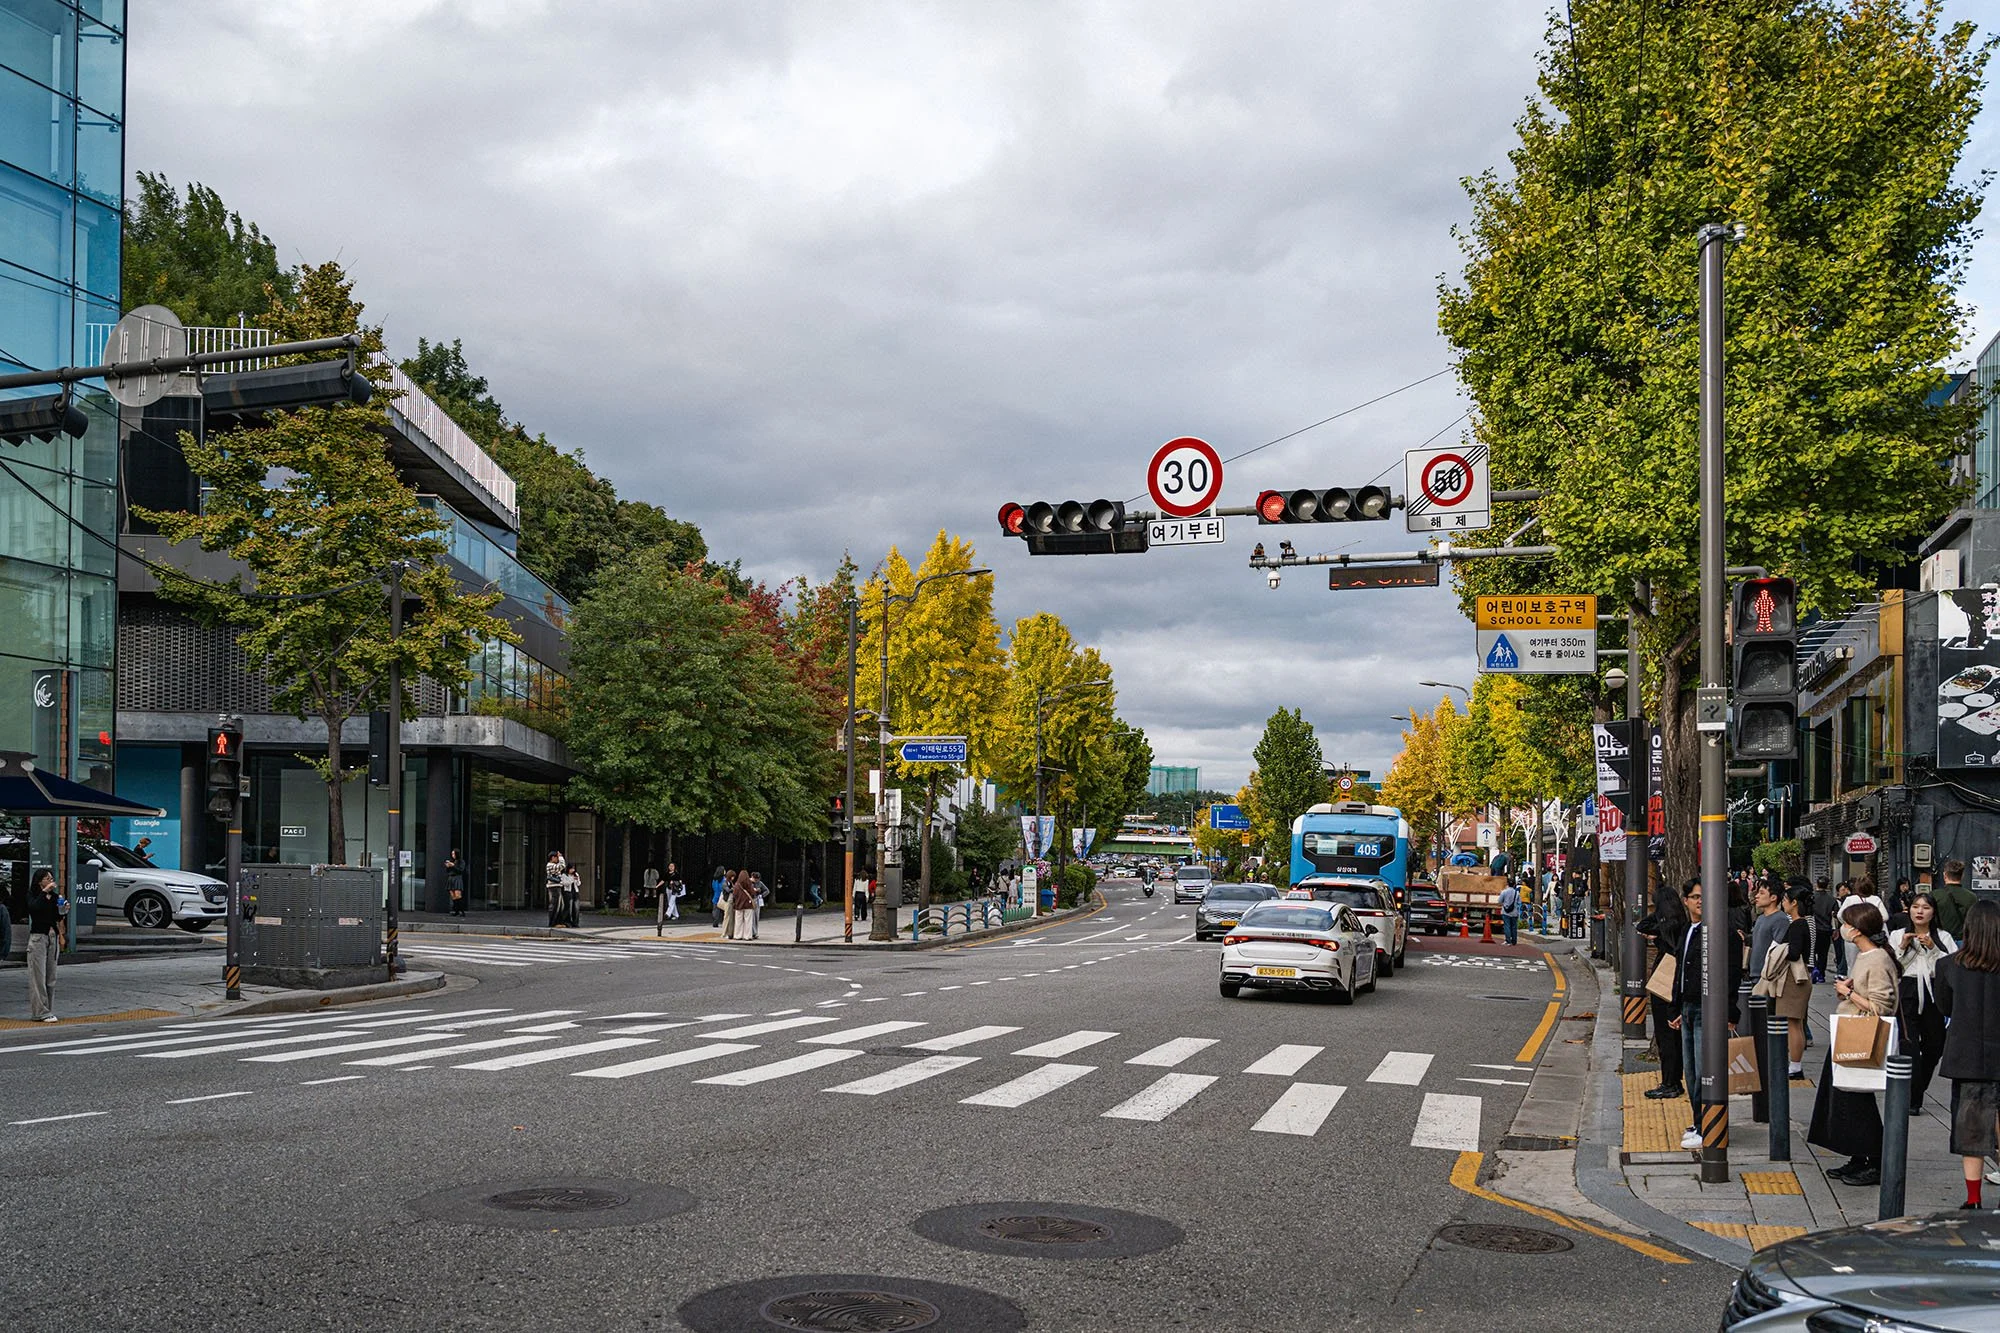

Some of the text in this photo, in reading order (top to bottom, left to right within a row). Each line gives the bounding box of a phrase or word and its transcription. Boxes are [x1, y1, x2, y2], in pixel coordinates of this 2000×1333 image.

[1164, 459, 1208, 494] 30
[1434, 469, 1461, 492] 50
[1152, 521, 1220, 541] 여기부터
[1486, 600, 1586, 613] 어린이보호구역
[1490, 616, 1582, 624] SCHOOL ZONE
[1529, 638, 1586, 647] 여기부터 350m
[1530, 650, 1586, 658] 속도를 줄이시오
[921, 745, 963, 753] 이태원로55길
[1357, 844, 1378, 855] 405
